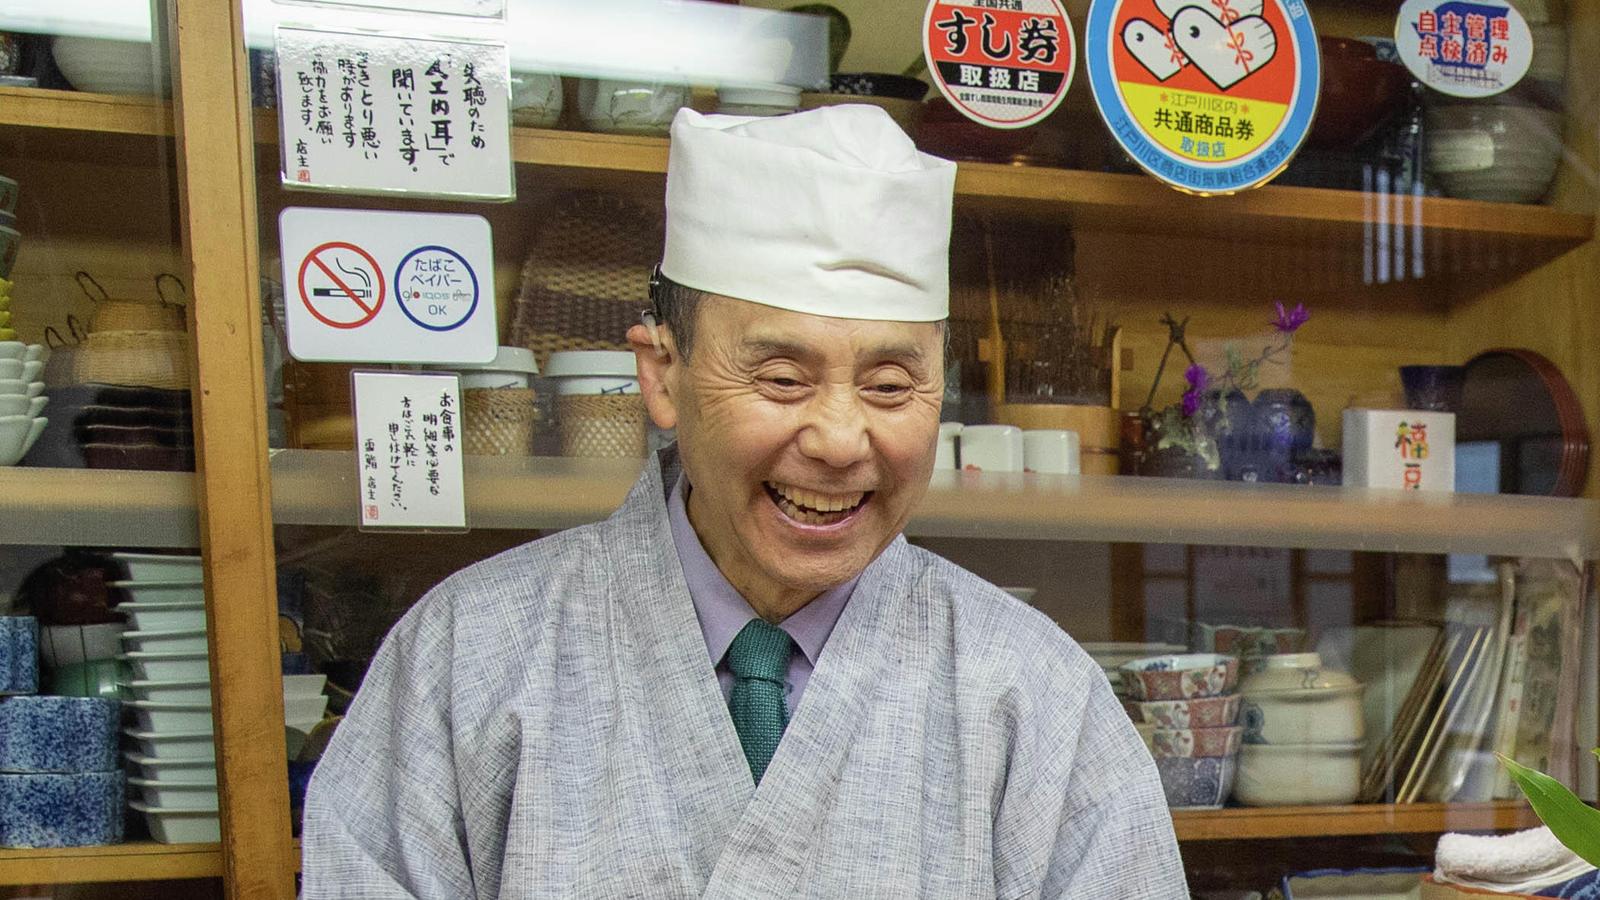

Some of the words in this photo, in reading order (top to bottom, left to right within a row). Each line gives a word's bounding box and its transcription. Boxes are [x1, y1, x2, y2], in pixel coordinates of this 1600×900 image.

[936, 10, 1059, 65] すし券
[1418, 10, 1510, 40] 自主管理
[1417, 35, 1509, 64] 点検済み
[960, 65, 1040, 92] 取扱店
[1171, 93, 1239, 114] 江戸川区内
[1154, 108, 1255, 141] 共通商品券
[1180, 136, 1227, 158] 取扱店
[414, 257, 457, 273] たばこ
[427, 304, 448, 316] OK
